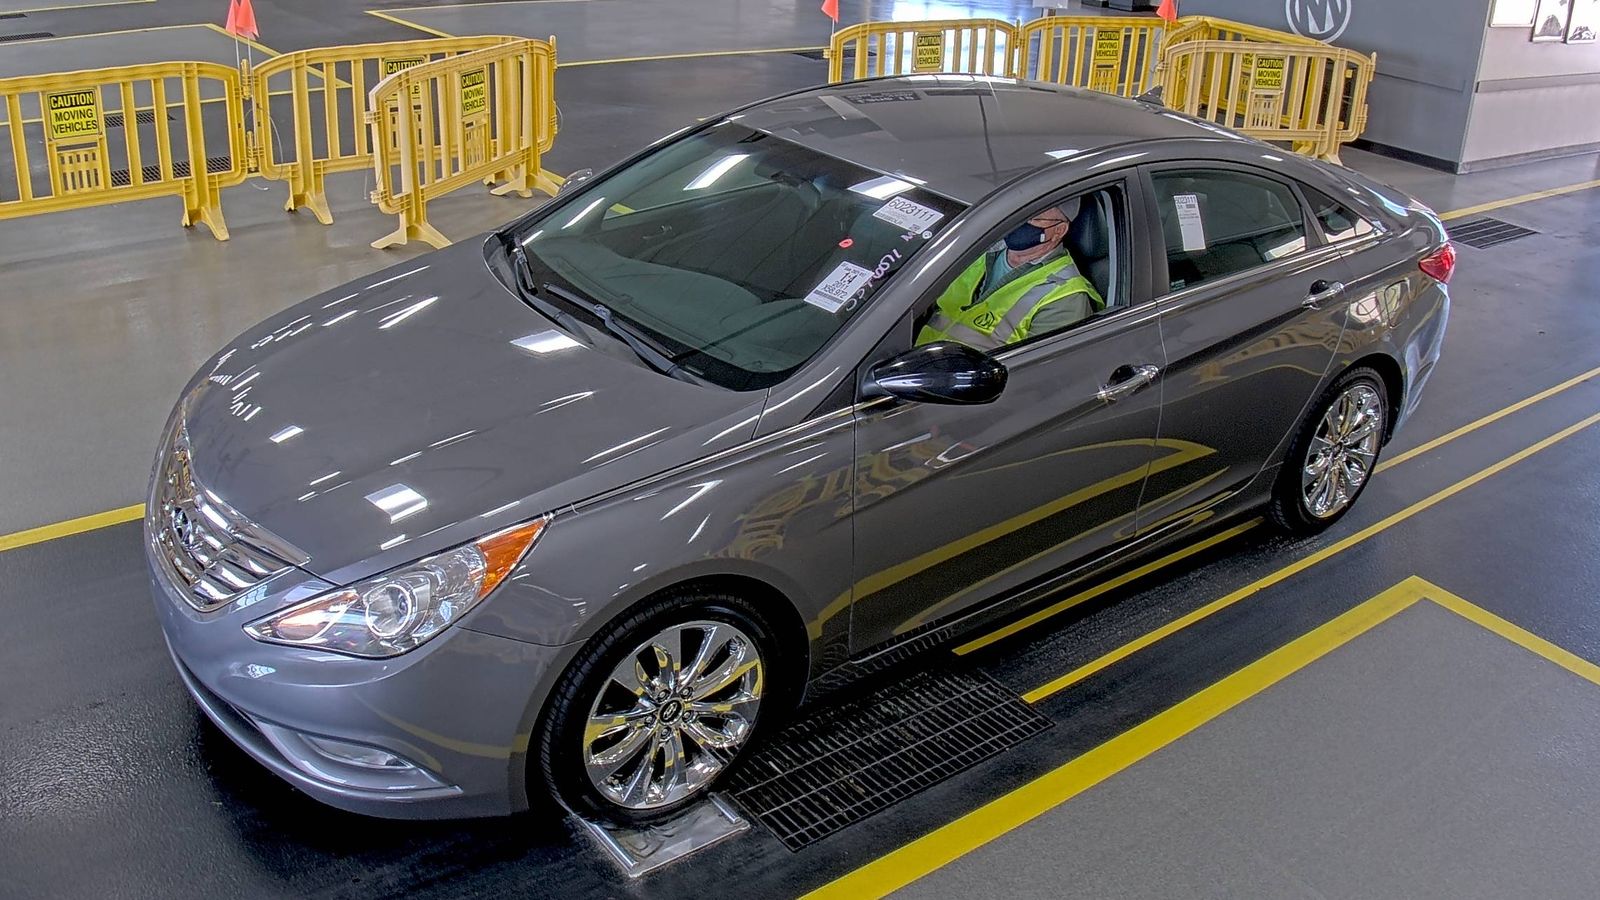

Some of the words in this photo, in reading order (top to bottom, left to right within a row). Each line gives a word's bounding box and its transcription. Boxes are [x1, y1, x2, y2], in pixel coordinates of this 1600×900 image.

[1098, 31, 1119, 40] CAUTION
[918, 48, 939, 56] MOVING
[917, 56, 940, 65] VEHICLES
[1257, 58, 1282, 68] CAUTION
[462, 72, 484, 88] CAUTION
[1258, 70, 1281, 78] MOVING
[1256, 78, 1281, 87] VEHICLES
[50, 92, 93, 108] CAUTION
[464, 86, 483, 100] MOVING
[462, 97, 485, 112] VEHICLES
[54, 108, 94, 122] MOVING
[53, 120, 98, 134] VEHICLES
[888, 198, 936, 222] 6023111
